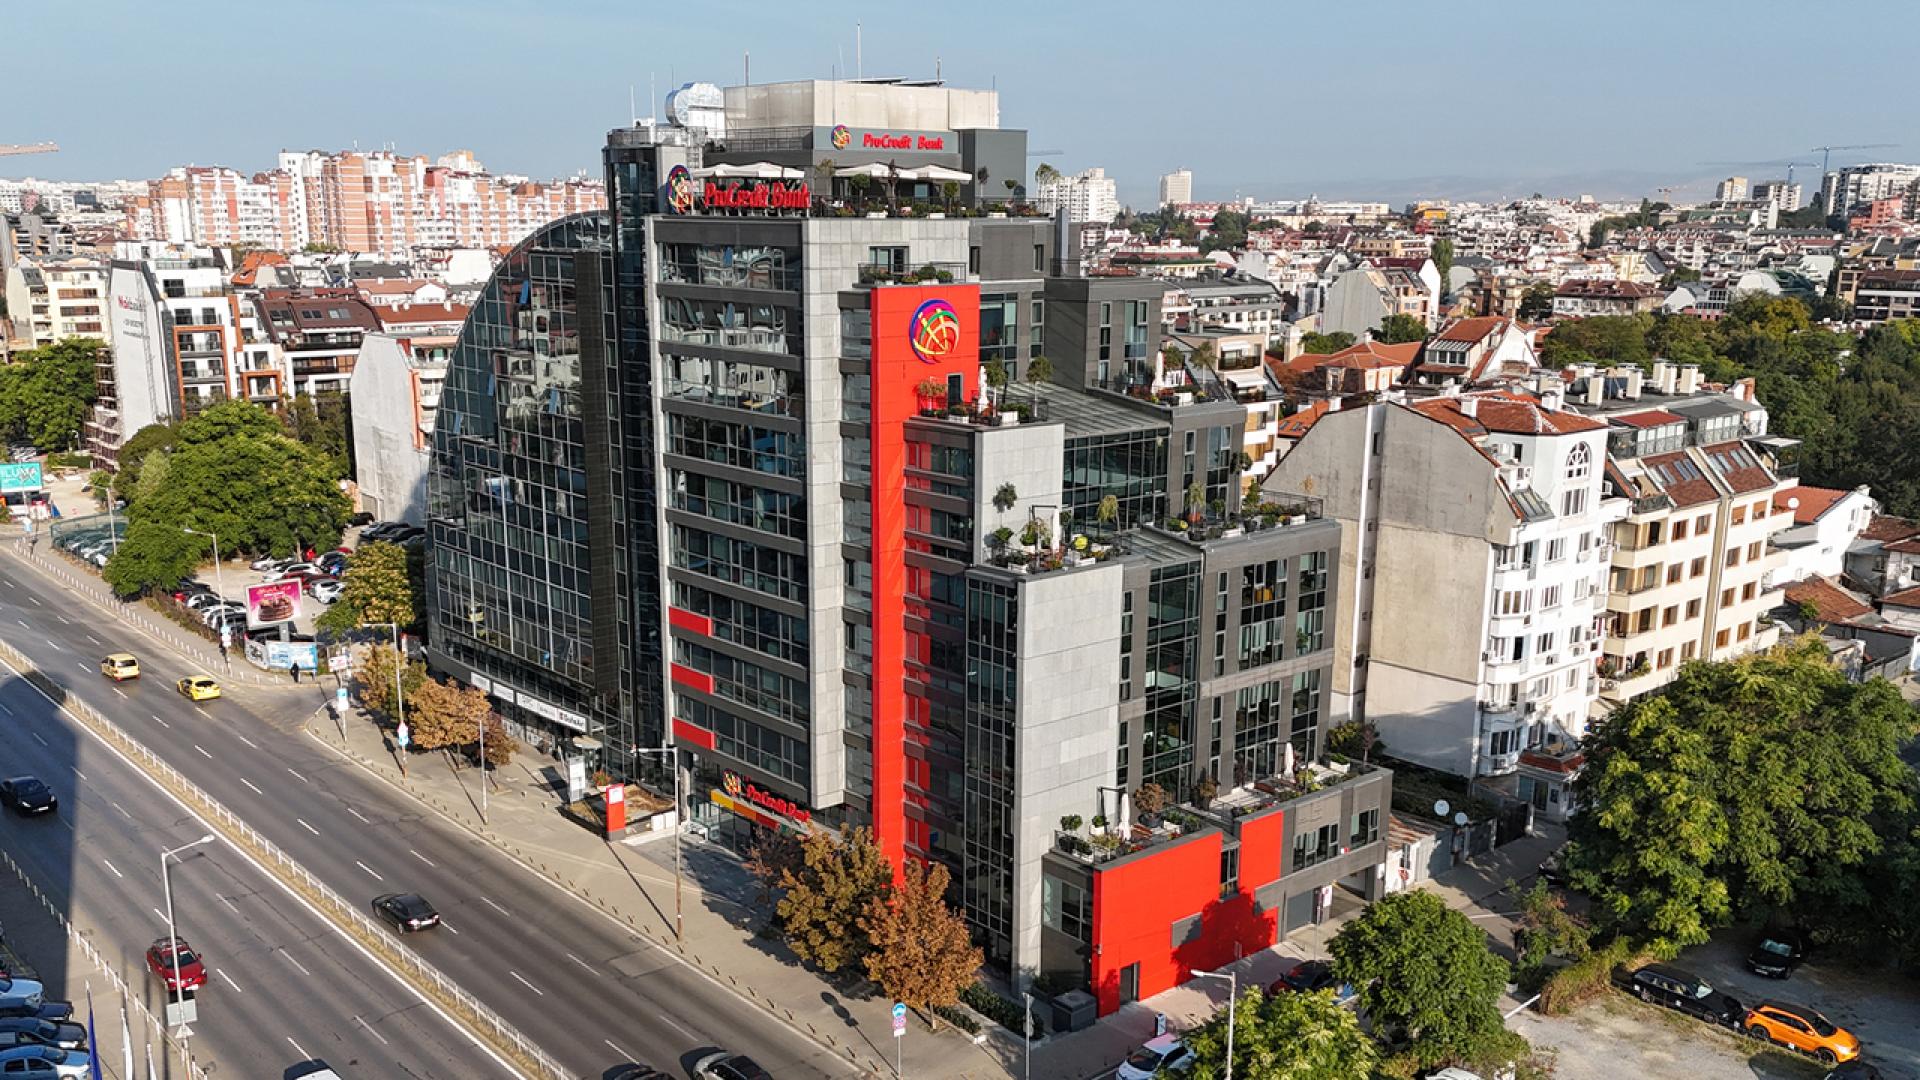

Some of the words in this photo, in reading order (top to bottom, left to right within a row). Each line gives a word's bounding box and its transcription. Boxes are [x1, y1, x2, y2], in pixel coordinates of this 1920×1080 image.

[863, 133, 912, 149] ProCredit
[917, 134, 943, 150] Bank
[704, 181, 769, 208] ProCredit
[772, 181, 811, 208] Bank
[746, 784, 787, 814] ProCredit
[788, 802, 811, 822] Bank
